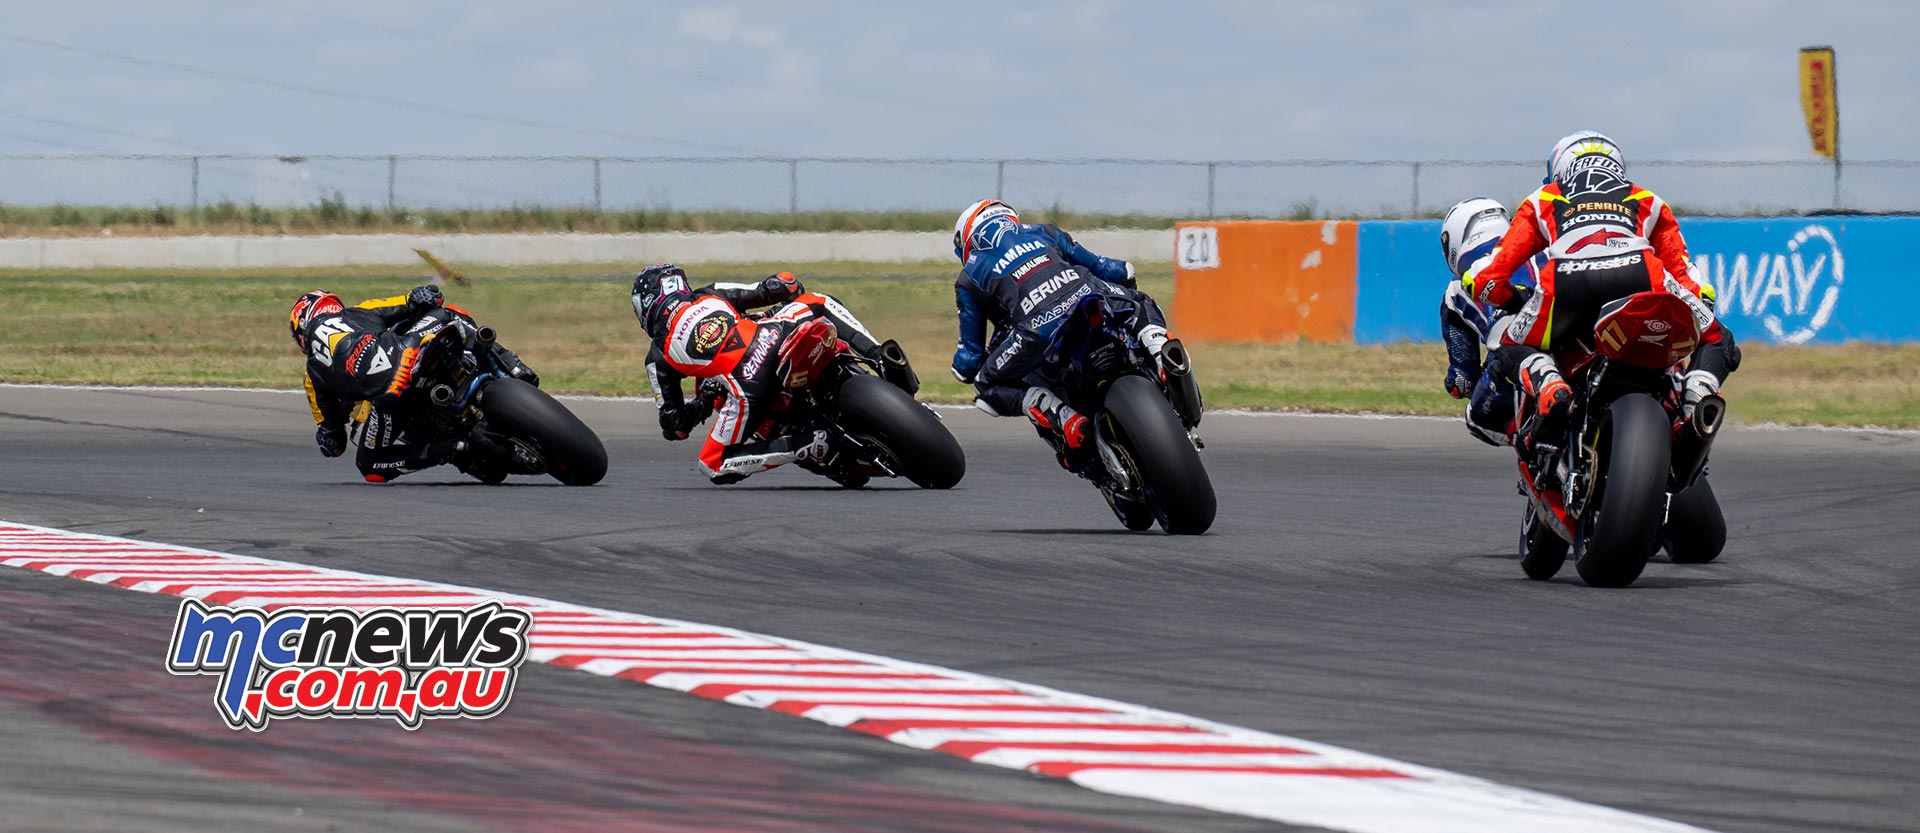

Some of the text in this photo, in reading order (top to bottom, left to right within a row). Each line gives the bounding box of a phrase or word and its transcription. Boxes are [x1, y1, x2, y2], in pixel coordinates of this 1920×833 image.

[1566, 168, 1630, 200] 17
[1561, 213, 1634, 231] HONDA
[1577, 203, 1632, 217] PENRITE
[992, 240, 1046, 275] YAMAHA
[1012, 254, 1050, 280] YAMALUBE
[1557, 254, 1642, 275] alpinestars
[1020, 268, 1080, 315] BERING
[677, 305, 709, 341] HONDA
[696, 316, 728, 353] PENRITE
[1600, 319, 1628, 352] 17
[311, 317, 355, 368] CAT
[743, 341, 770, 380] SENNA
